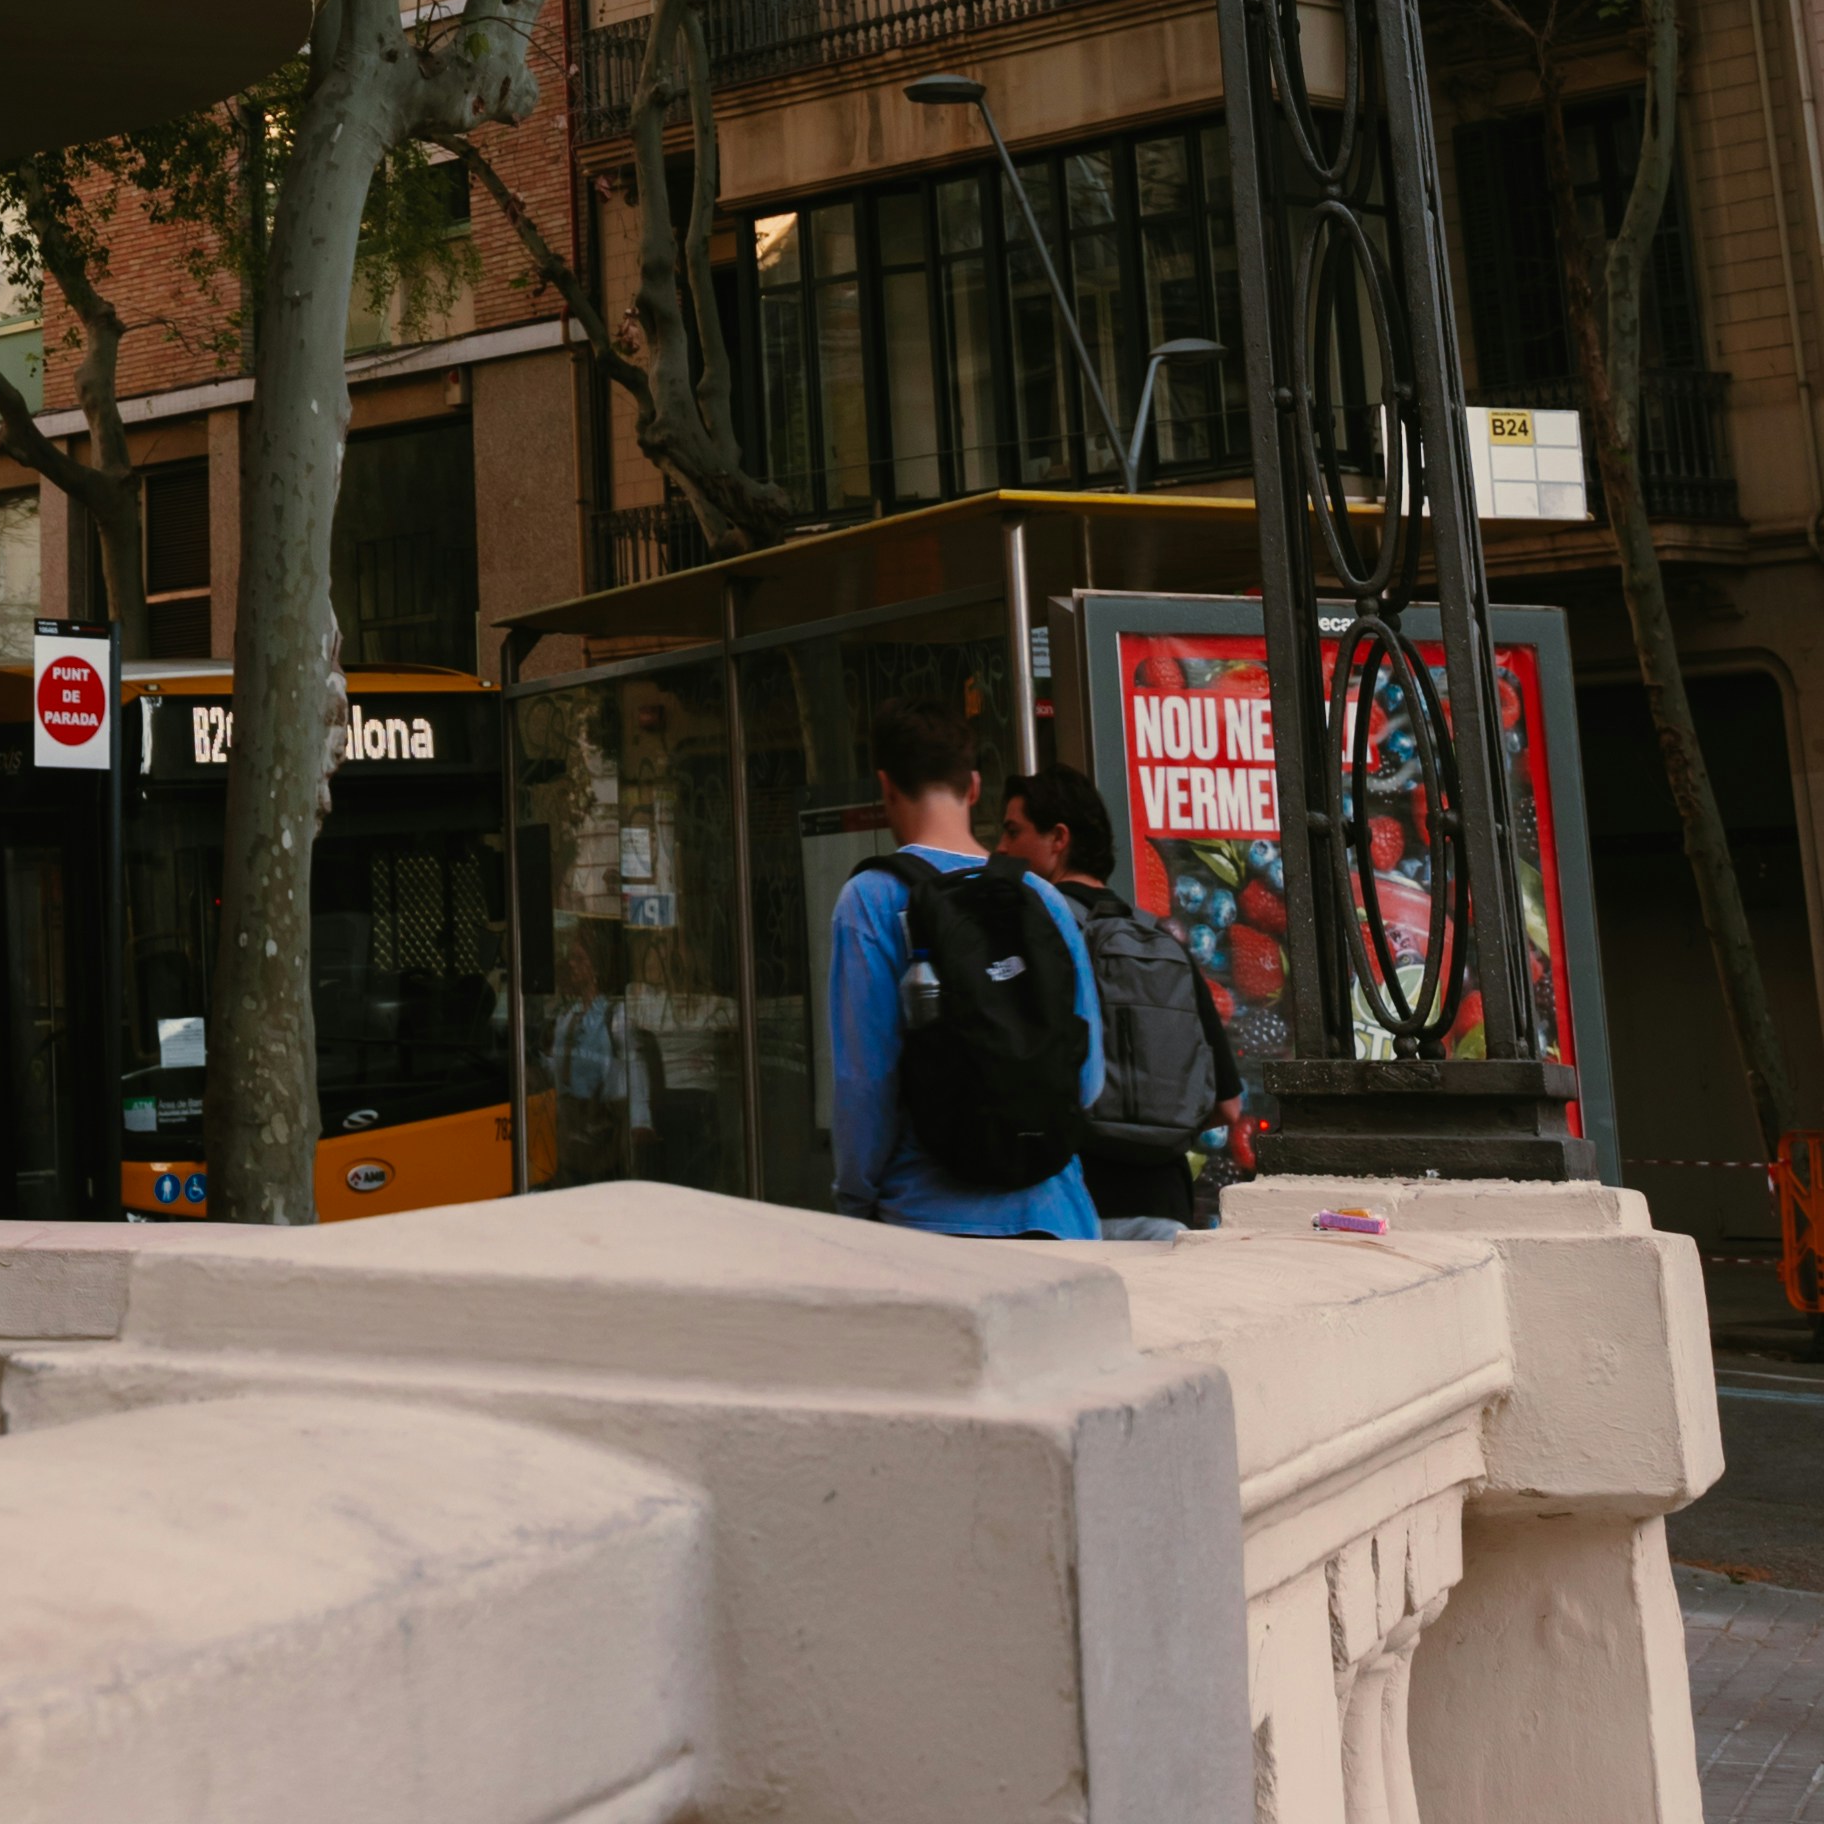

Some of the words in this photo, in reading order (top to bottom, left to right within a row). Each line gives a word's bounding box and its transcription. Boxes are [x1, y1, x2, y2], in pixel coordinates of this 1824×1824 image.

[1492, 418, 1528, 436] B24
[52, 667, 90, 681] PUNT
[62, 690, 81, 703] DE
[44, 711, 99, 727] PARADA
[1133, 695, 1219, 761] NOU
[342, 705, 434, 760] lona
[1138, 765, 1280, 831] VERME
